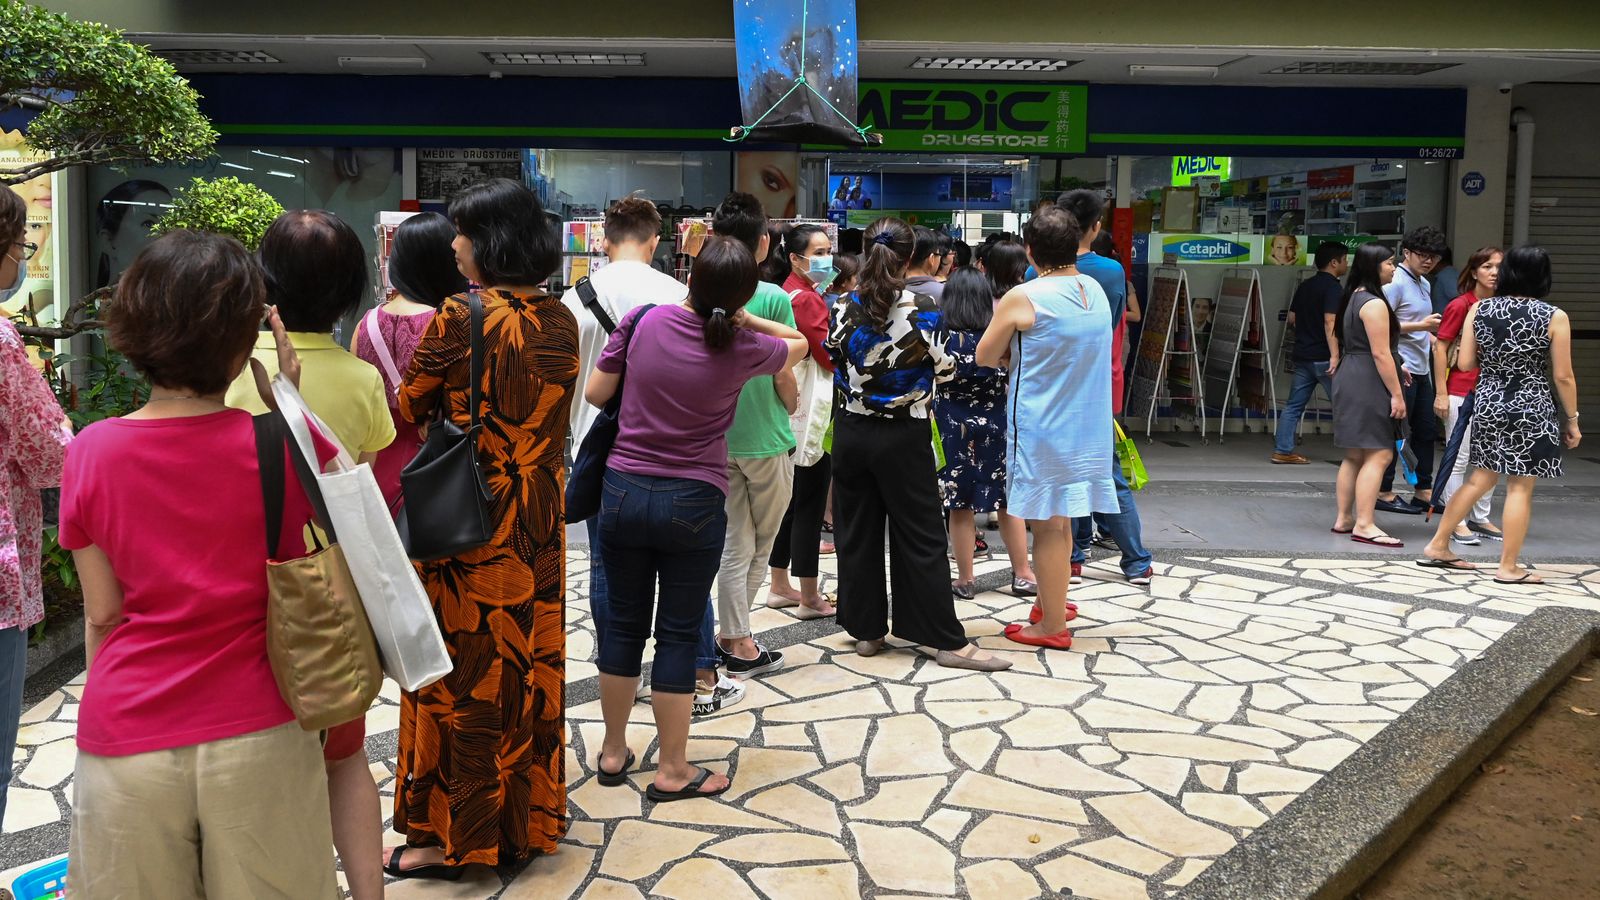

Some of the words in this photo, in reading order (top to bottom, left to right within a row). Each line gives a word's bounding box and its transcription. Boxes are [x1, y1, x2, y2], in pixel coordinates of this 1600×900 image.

[922, 134, 1050, 147] DRUGSTORE
[423, 150, 455, 159] MEDIC
[463, 150, 519, 159] DRUGSTORE
[1419, 148, 1457, 158] 01-26/27
[1465, 180, 1482, 188] ADT
[1180, 242, 1232, 257] Cetaphil
